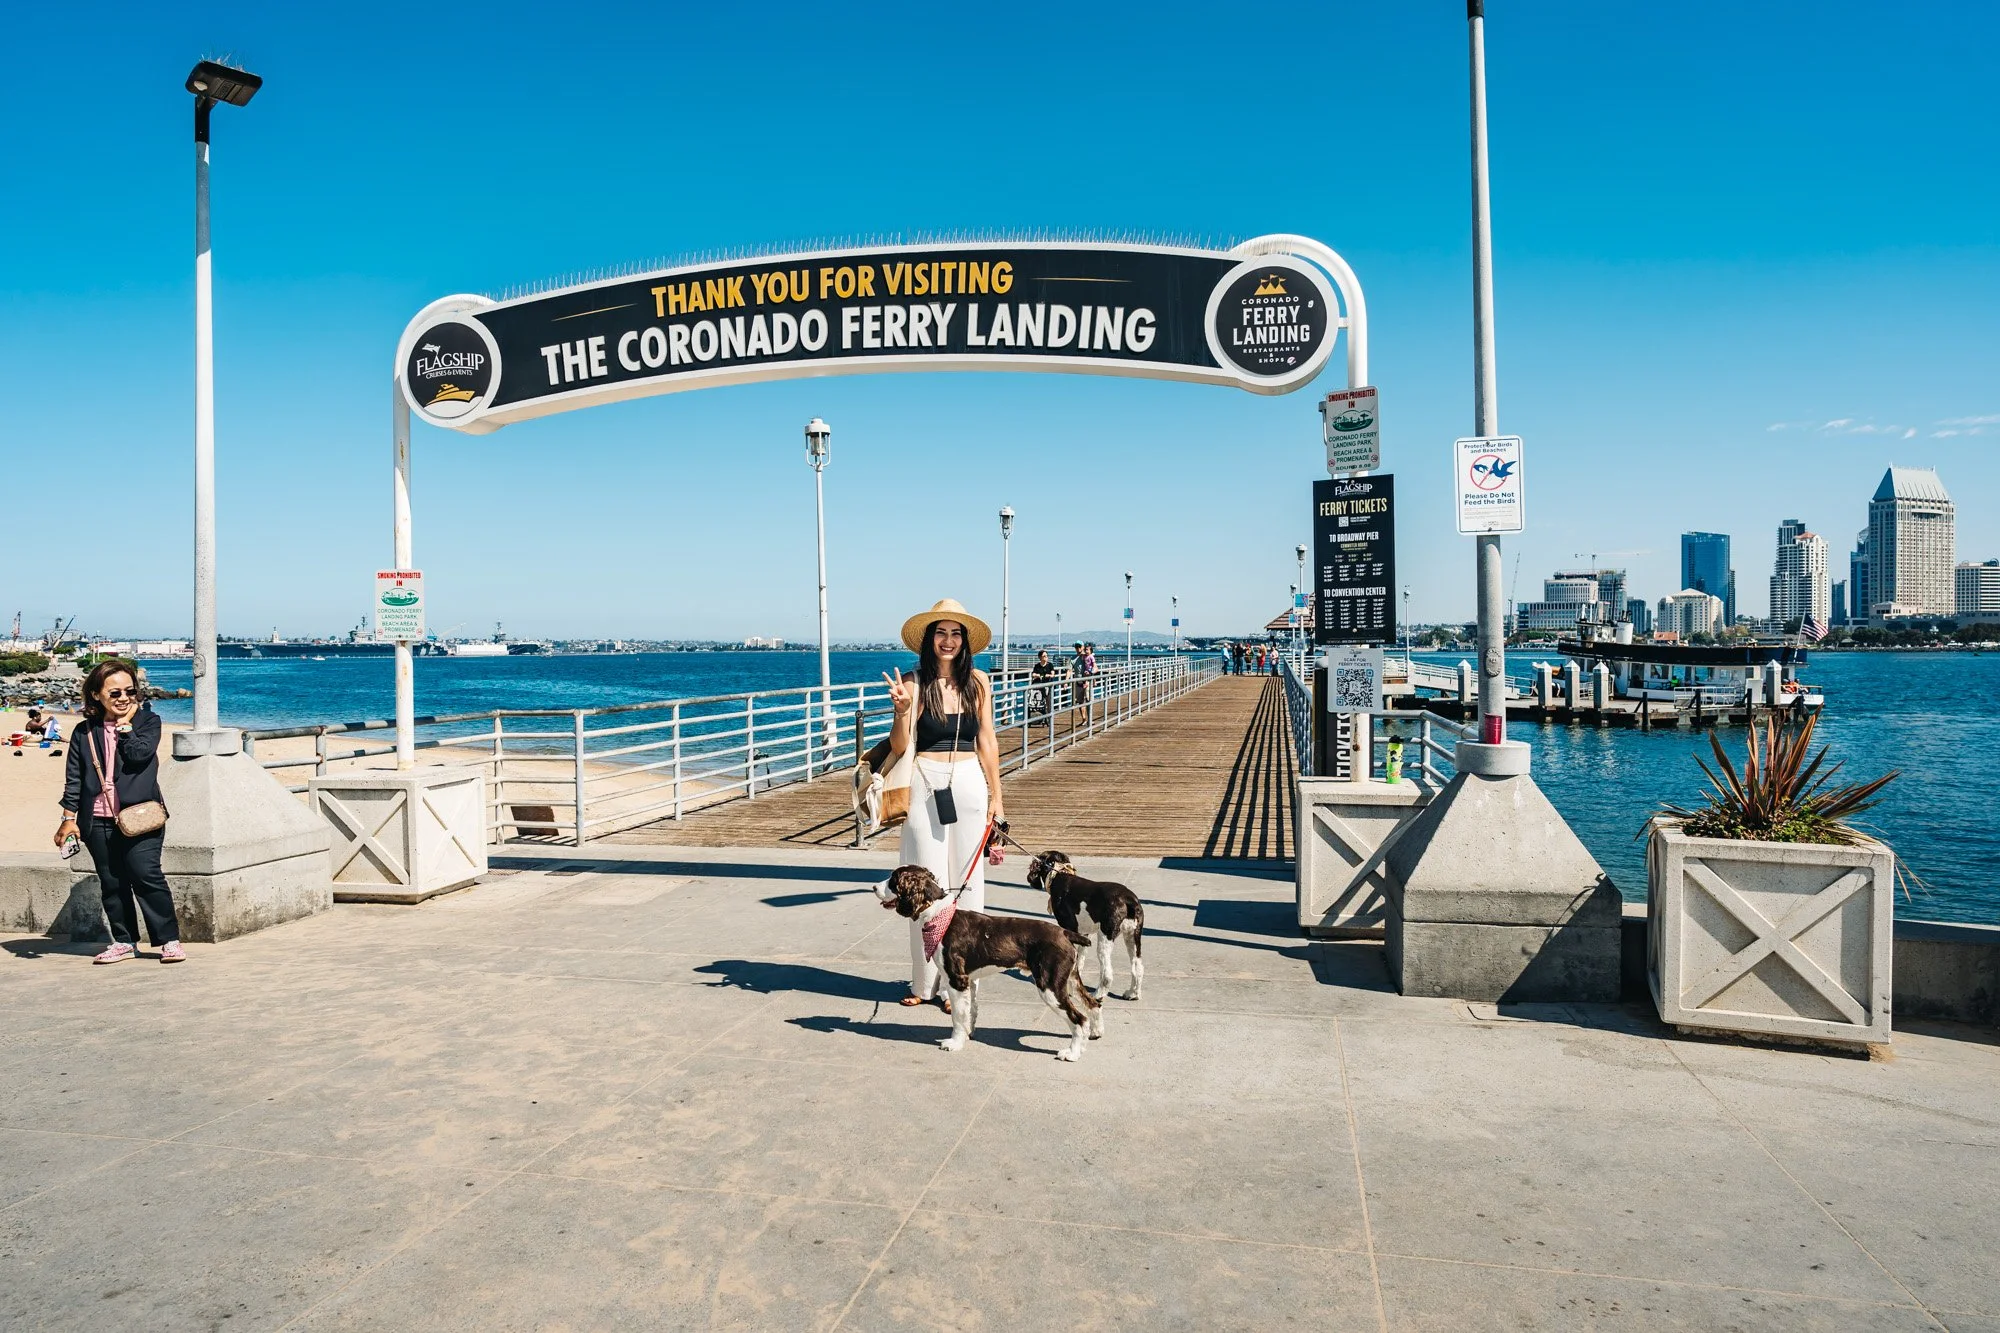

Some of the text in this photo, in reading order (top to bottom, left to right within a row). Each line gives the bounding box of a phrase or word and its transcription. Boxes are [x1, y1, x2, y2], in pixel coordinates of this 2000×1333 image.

[651, 261, 1013, 317] THANK YOU FOR VISITING
[1241, 296, 1299, 305] CORONADO
[1242, 305, 1300, 326] FERRY
[1233, 324, 1310, 346] LANDING
[541, 302, 1157, 386] THE CORONADO FERRY LANDING
[416, 352, 485, 377] FLAGSHIP
[425, 370, 446, 379] CRUISES
[1328, 388, 1375, 402] SMOKING PROHIBITED
[1328, 431, 1378, 442] CORONADO FERRY
[1332, 440, 1356, 448] LANDING
[1333, 449, 1352, 457] BEACH
[1353, 447, 1368, 455] AREA
[1336, 454, 1370, 463] PROMENADE
[1335, 483, 1373, 496] FLAGSHIP
[1320, 497, 1388, 516] FERRY TICKETS
[1329, 531, 1379, 543] TO BROADWAY PIER
[1323, 586, 1386, 597] TO CONVENTION CENTER
